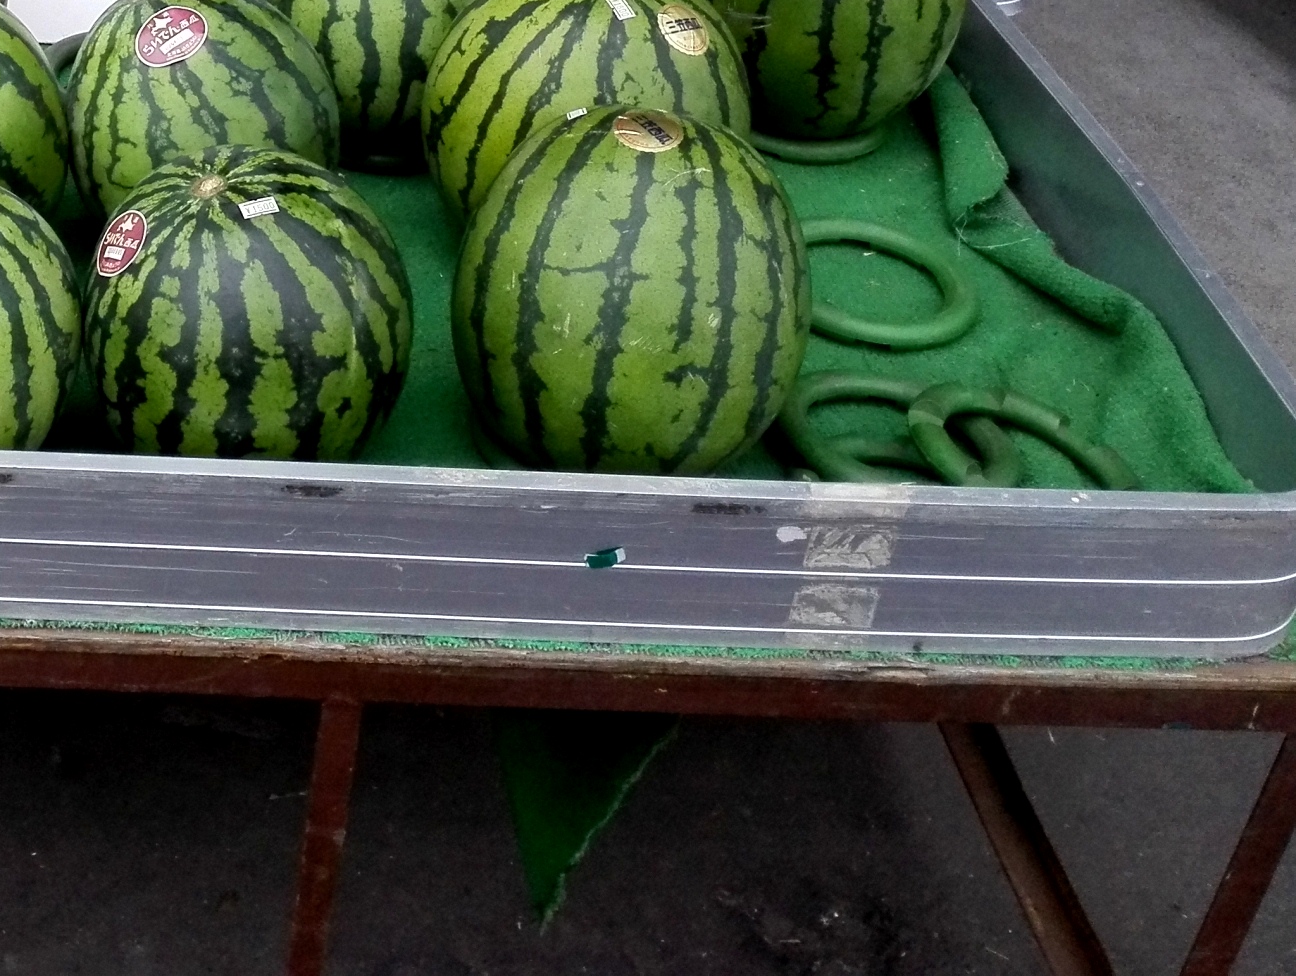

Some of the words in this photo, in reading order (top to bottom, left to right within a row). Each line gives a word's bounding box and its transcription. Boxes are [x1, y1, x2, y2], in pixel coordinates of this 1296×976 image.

[142, 14, 200, 57] らいでん西瓜
[245, 201, 276, 215] ¥1500
